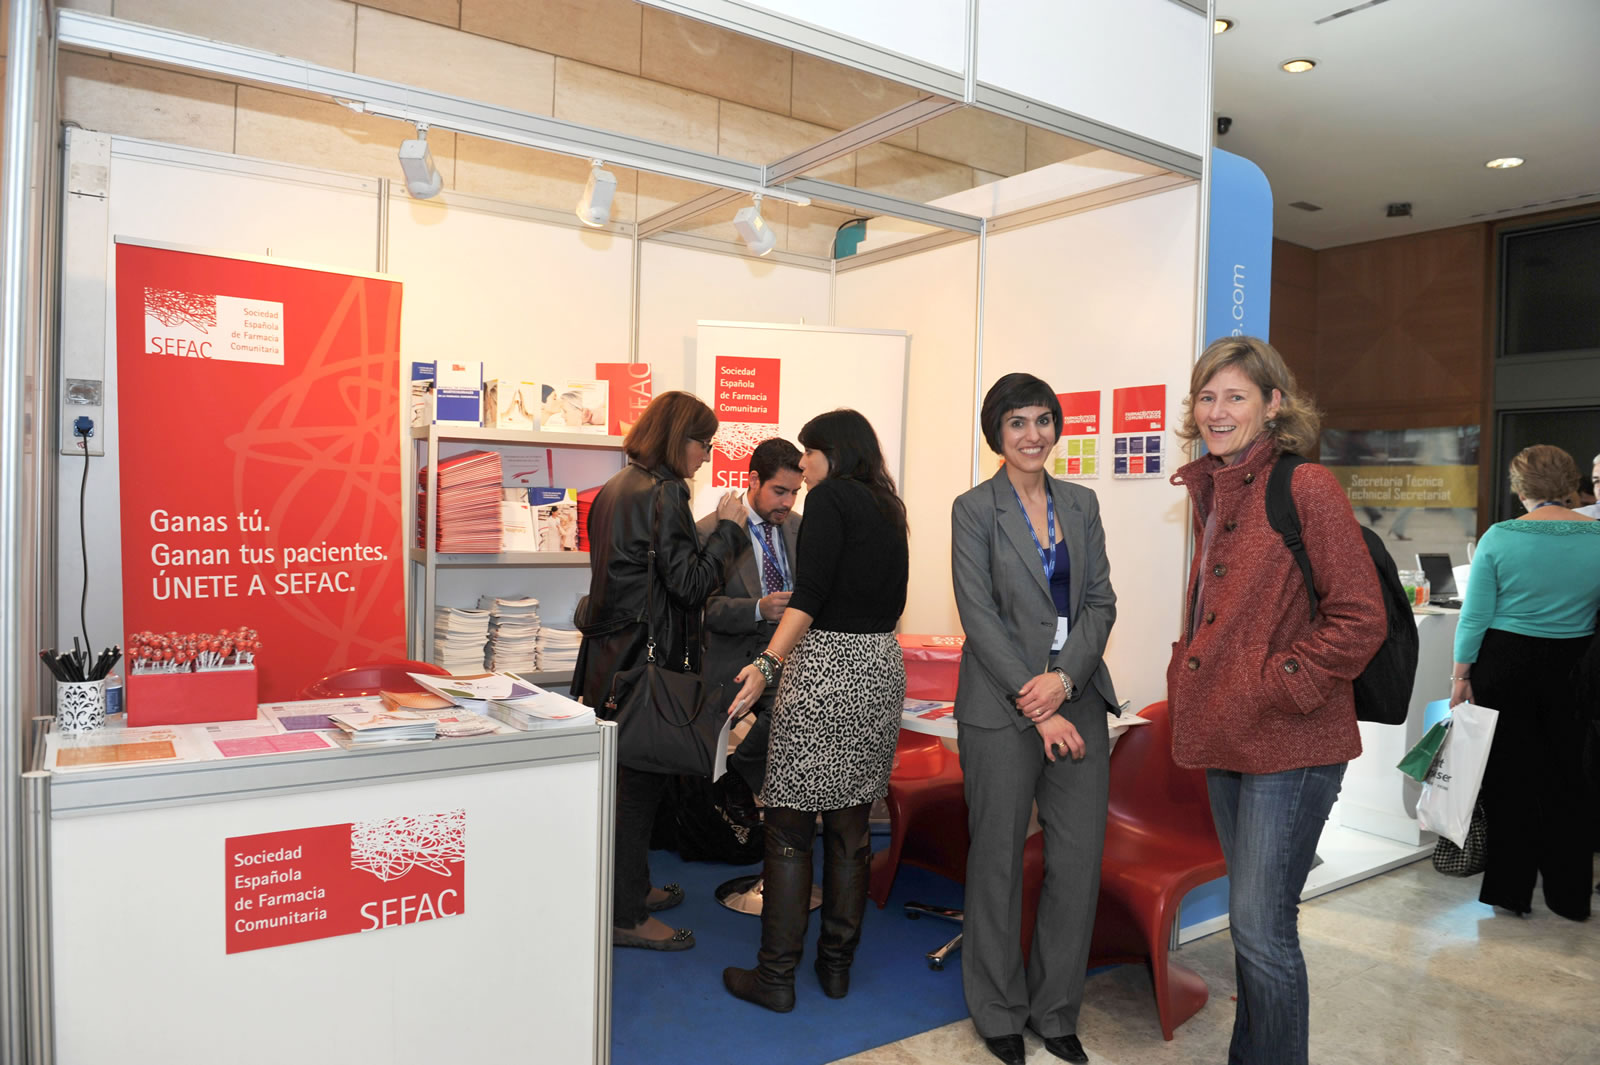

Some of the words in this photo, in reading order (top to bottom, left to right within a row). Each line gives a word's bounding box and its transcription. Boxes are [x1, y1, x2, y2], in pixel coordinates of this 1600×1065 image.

[243, 307, 279, 319] Sociedad
[244, 320, 279, 331] Española
[231, 330, 241, 339] de
[243, 332, 279, 343] Farmacia
[151, 336, 213, 359] SEFAC
[230, 342, 279, 354] Comunitaria
[720, 366, 756, 376] Sociedad
[720, 379, 755, 389] Española
[719, 391, 730, 400] de
[732, 391, 768, 401] Farmacia
[719, 403, 768, 414] Comunitaria
[1351, 474, 1403, 487] Secretaria
[1406, 473, 1444, 487] Técnica
[1347, 487, 1392, 500] Technical
[1394, 487, 1451, 500] Secretariat
[150, 509, 228, 533] Ganas
[237, 508, 270, 532] tú.
[151, 543, 230, 567] Ganan
[239, 544, 275, 564] tus
[283, 541, 388, 569] pacientes.
[152, 569, 238, 600] ÚNETE
[247, 574, 266, 596] A
[274, 571, 356, 595] SEFAC.
[234, 845, 302, 867] Sociedad
[234, 868, 302, 890] Española
[234, 897, 253, 911] de
[258, 886, 326, 909] Farmacia
[360, 889, 458, 933] SEFAC
[234, 908, 327, 933] Comunitaria
